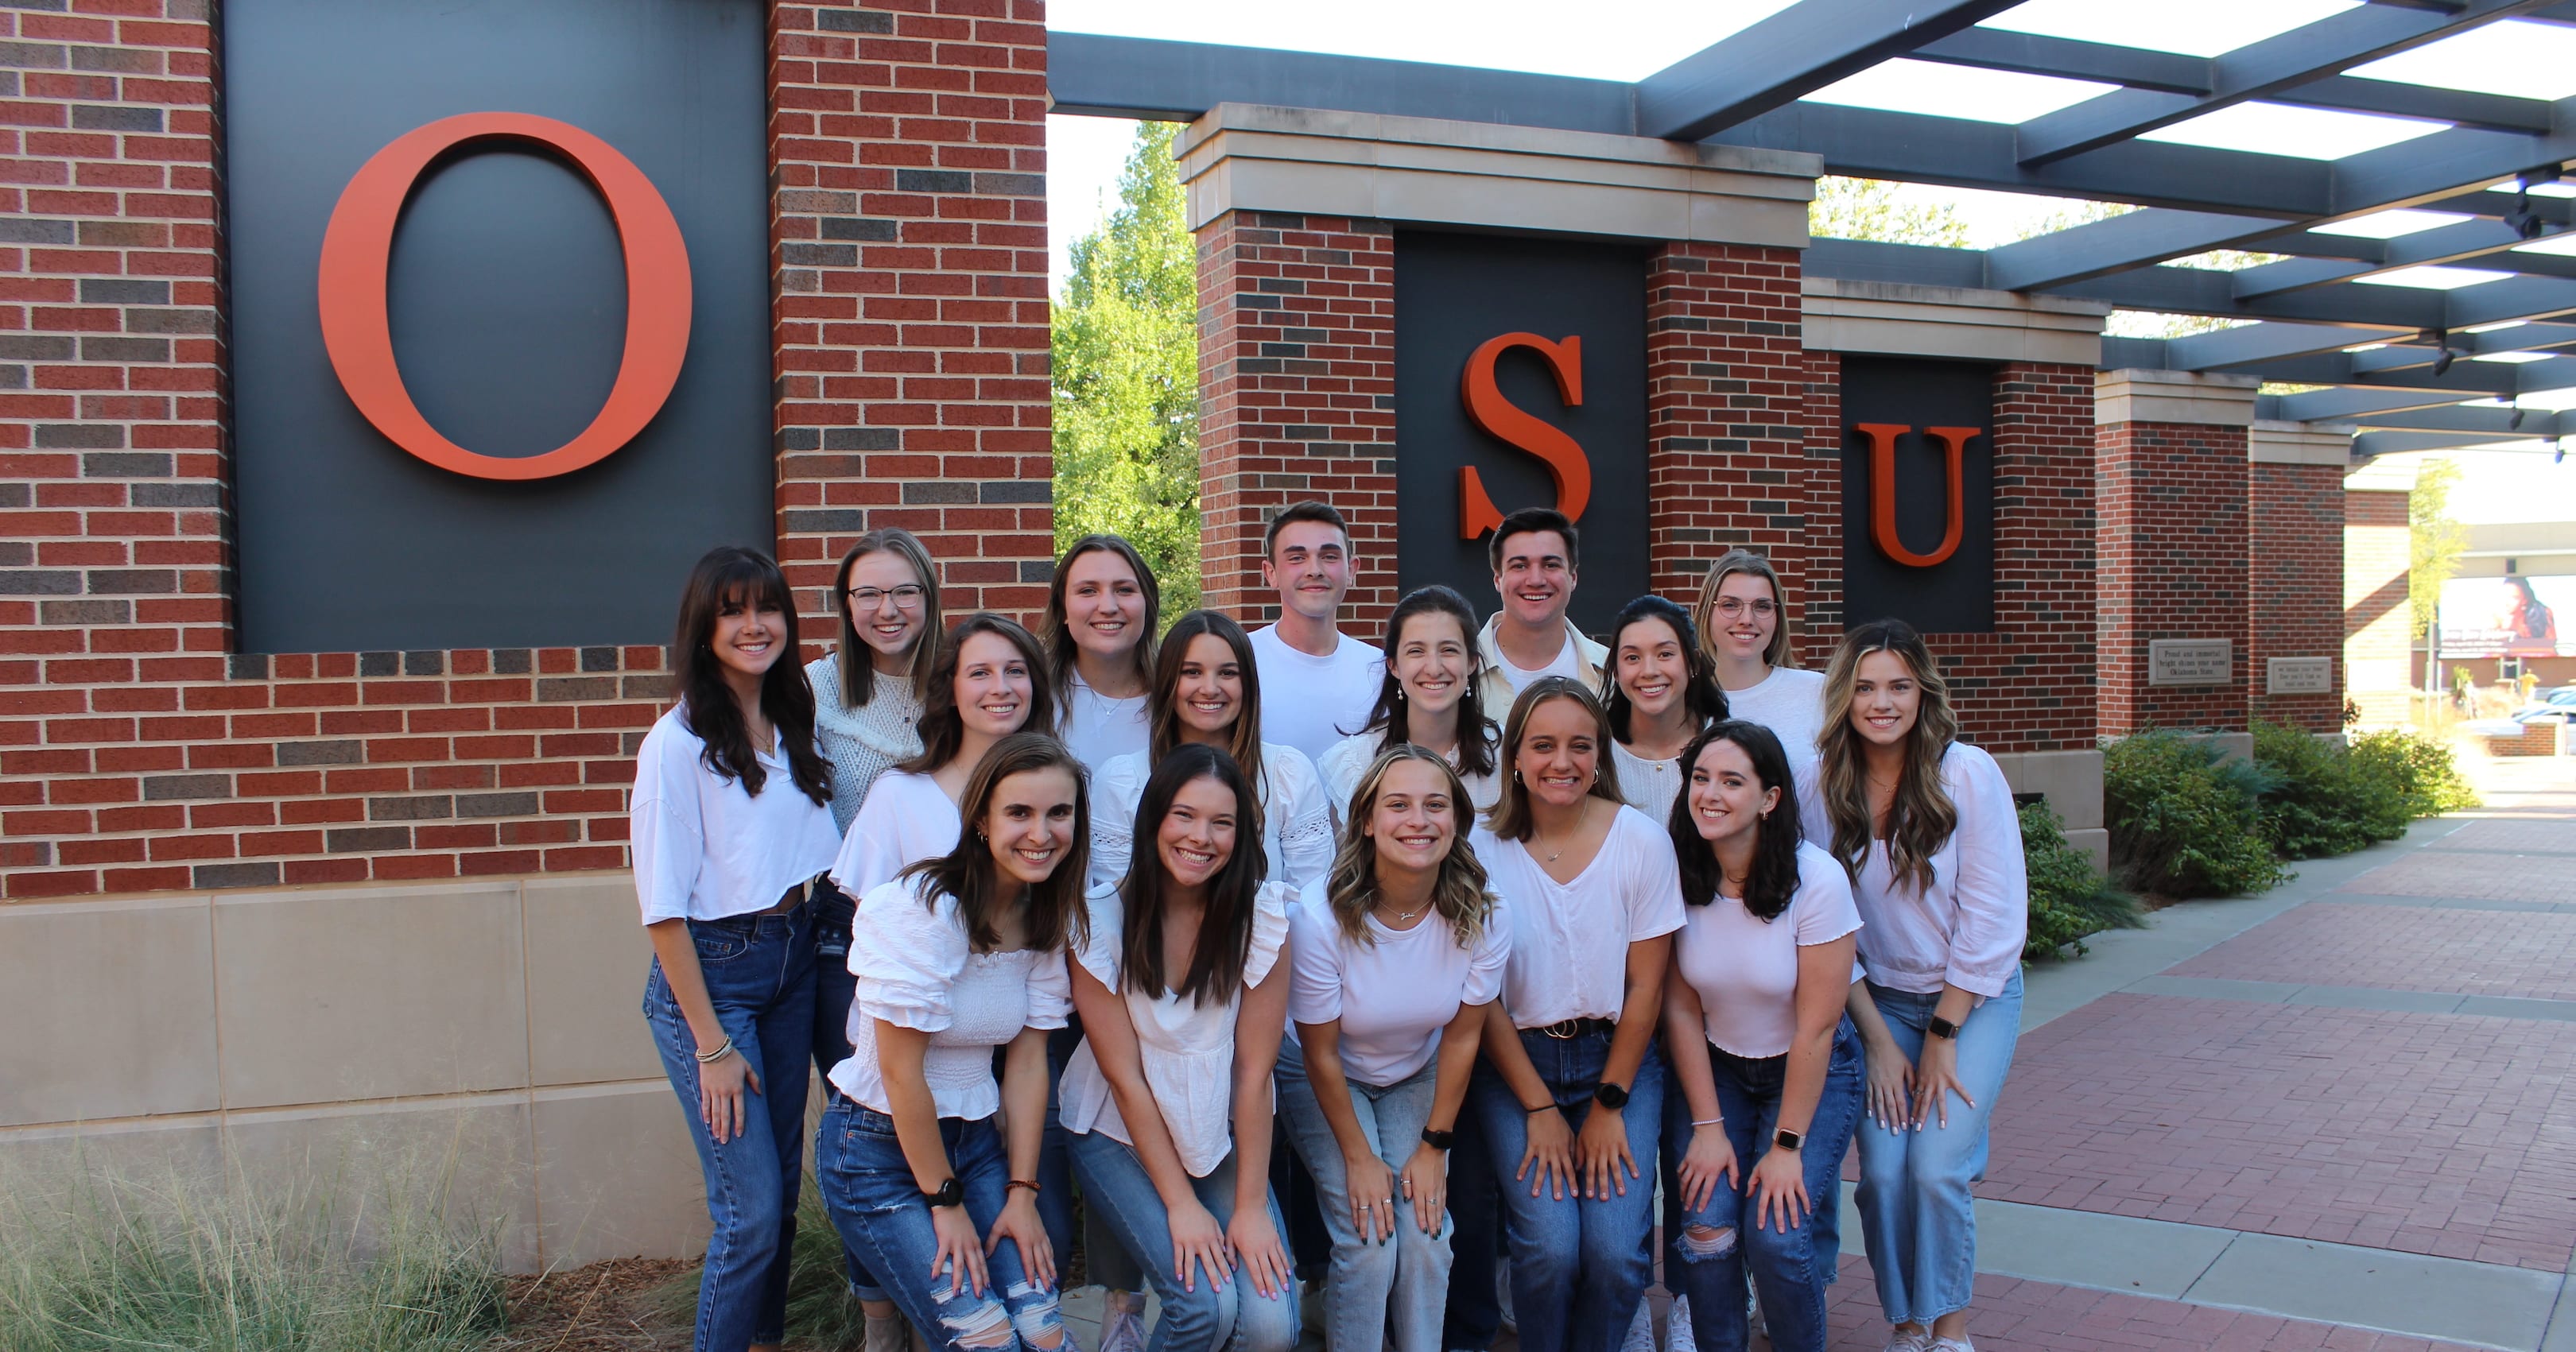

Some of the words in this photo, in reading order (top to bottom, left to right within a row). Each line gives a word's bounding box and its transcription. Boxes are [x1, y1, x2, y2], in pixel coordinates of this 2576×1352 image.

[318, 111, 693, 481] O
[1460, 331, 1592, 539] S
[1852, 423, 1981, 568] U
